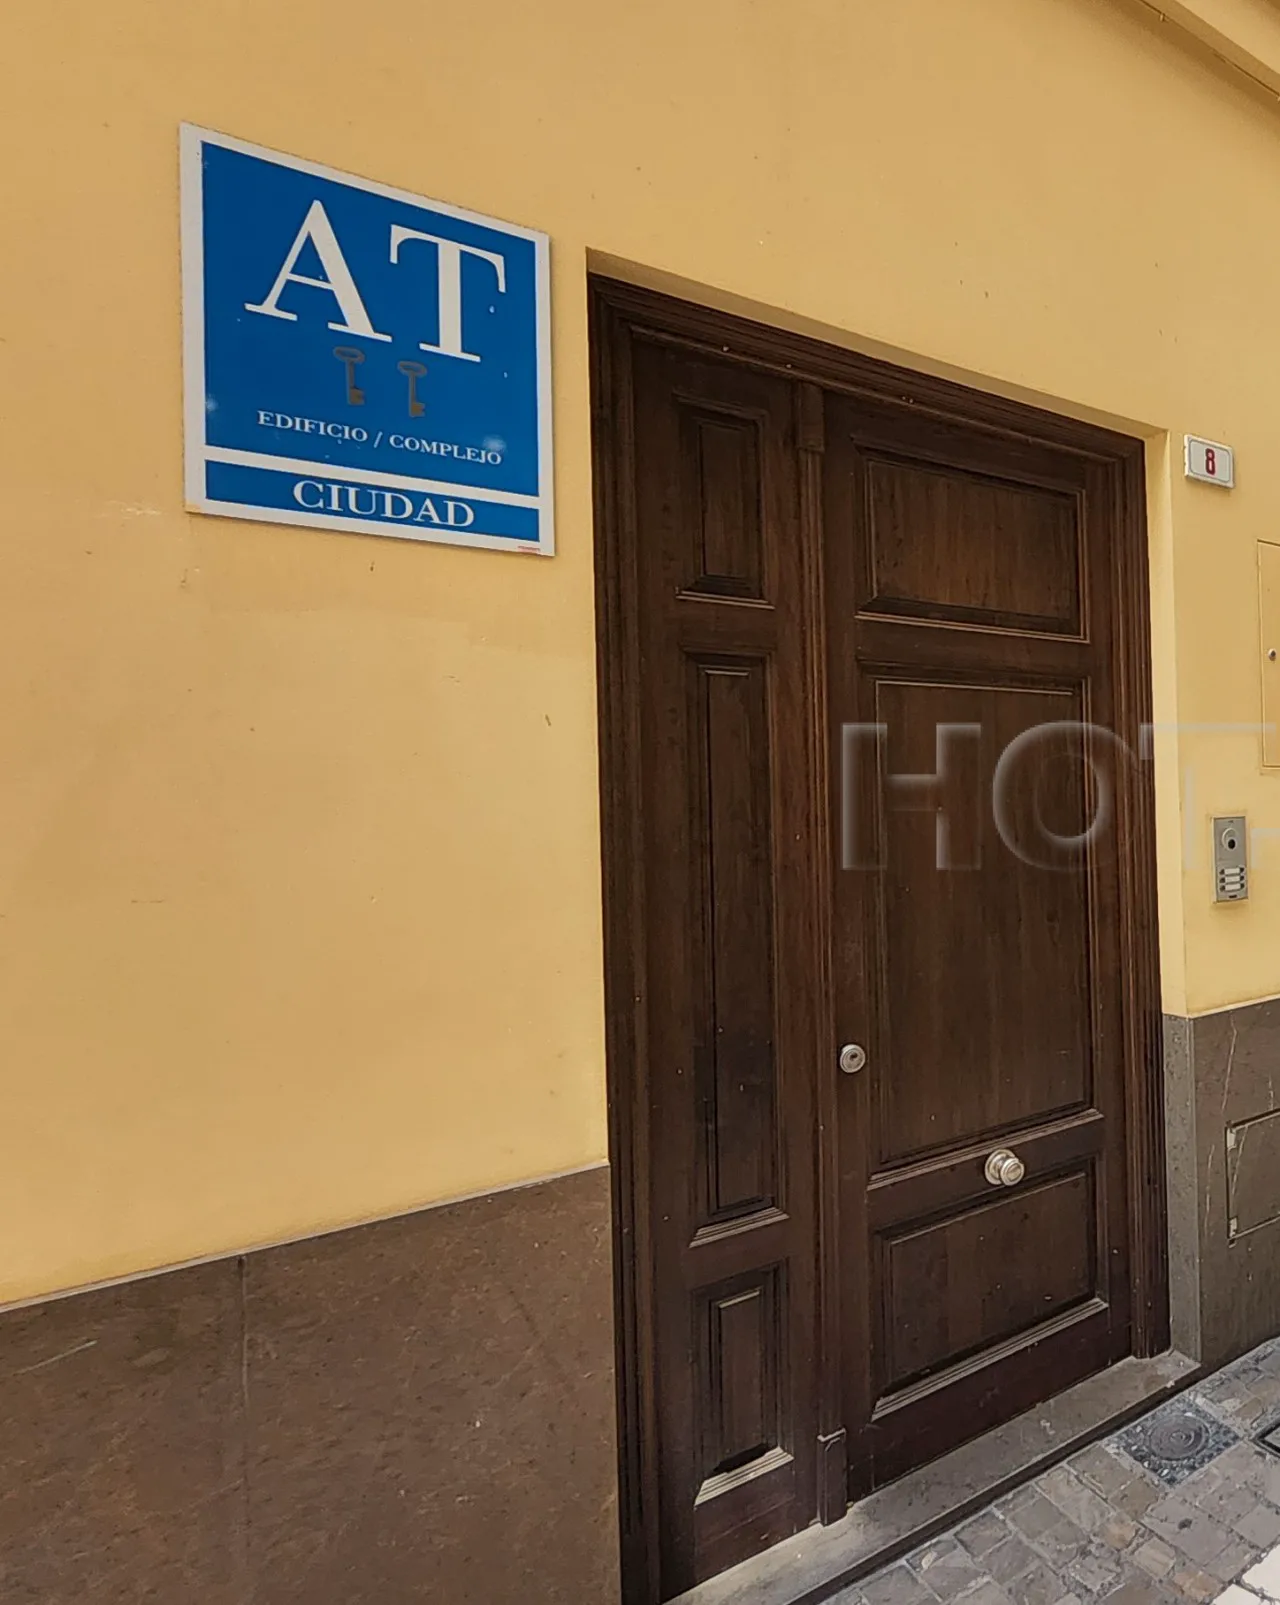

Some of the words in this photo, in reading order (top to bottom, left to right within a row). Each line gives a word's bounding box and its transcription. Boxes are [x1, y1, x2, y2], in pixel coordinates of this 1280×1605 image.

[244, 199, 506, 362] AT
[257, 410, 368, 442] EDIFICIO
[389, 434, 502, 466] COMPLEJO
[1205, 447, 1216, 476] 8
[293, 479, 474, 528] CIUDAD
